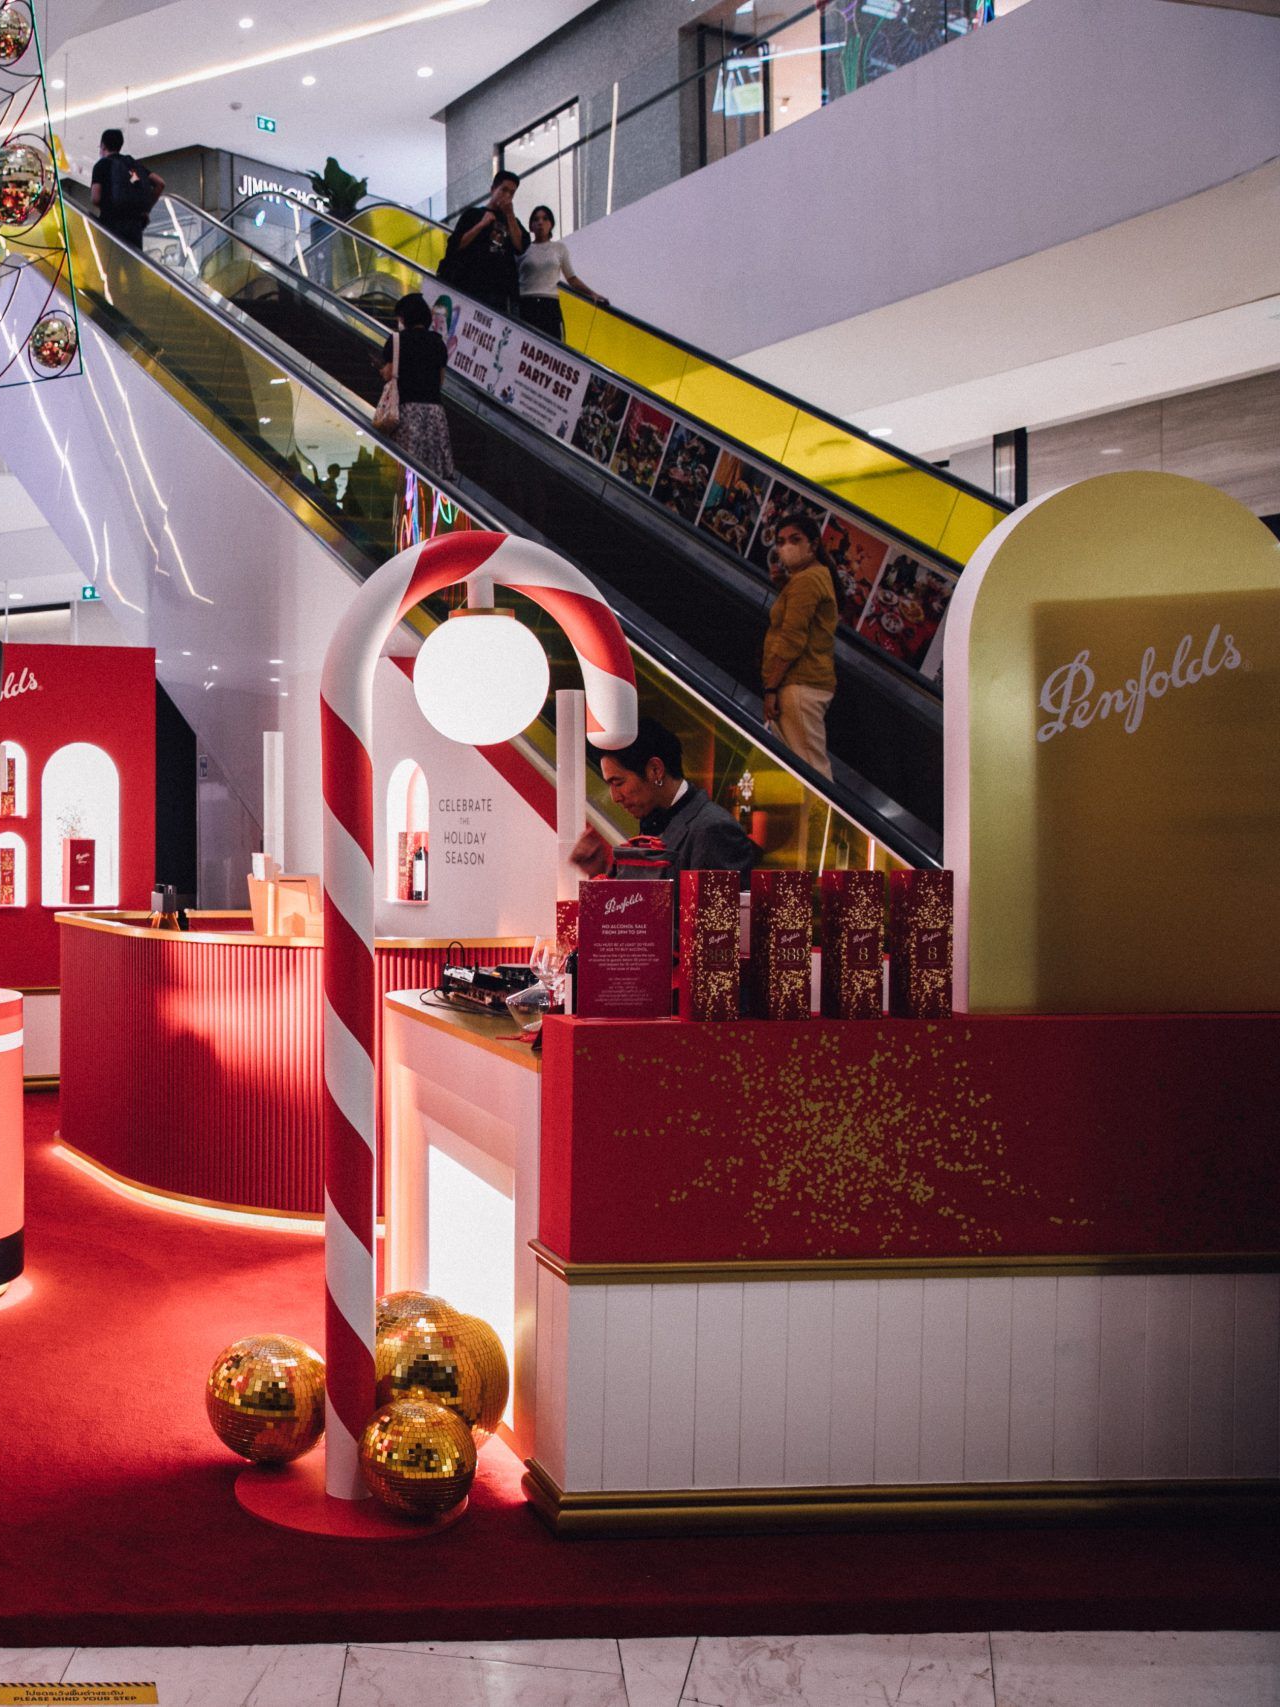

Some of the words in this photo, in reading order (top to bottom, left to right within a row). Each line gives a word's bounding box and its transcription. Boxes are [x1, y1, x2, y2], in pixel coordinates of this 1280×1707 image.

[238, 175, 282, 203] JIMMY
[520, 341, 580, 385] HAPPINESS
[518, 361, 554, 389] PARTY
[552, 381, 572, 402] SET
[1036, 624, 1241, 742] Penfolds
[438, 799, 492, 812] CELEBRATE
[459, 817, 470, 825] THE
[443, 832, 486, 845] HOLIDAY
[445, 851, 485, 865] SEASON
[777, 948, 807, 961] 389
[859, 947, 869, 961] 8
[928, 947, 937, 960] 8
